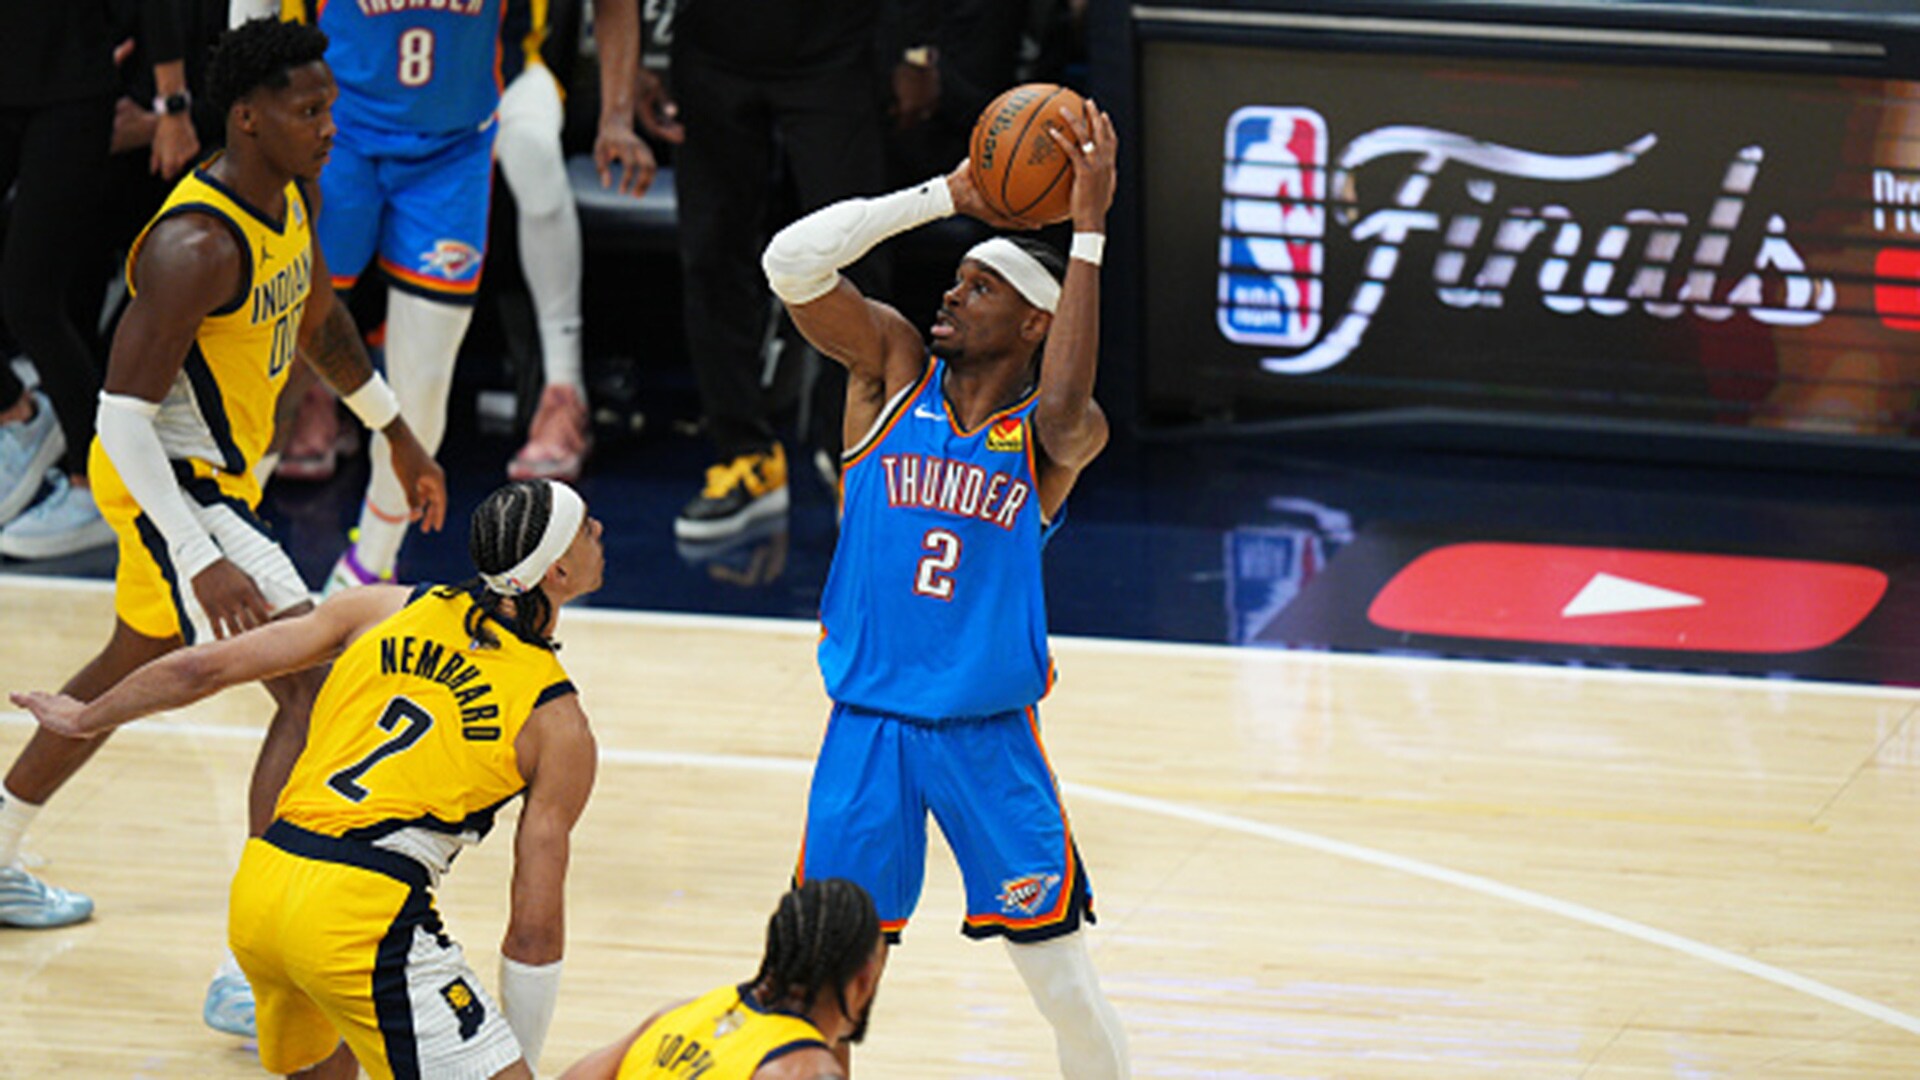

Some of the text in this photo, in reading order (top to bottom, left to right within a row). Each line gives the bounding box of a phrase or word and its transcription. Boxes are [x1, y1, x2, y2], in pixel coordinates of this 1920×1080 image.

[397, 27, 435, 88] 8
[1260, 125, 1836, 374] Finals
[882, 453, 1030, 532] THUNDER
[913, 527, 962, 602] 2
[380, 636, 501, 742] NEMBHARD
[325, 694, 434, 804] 2
